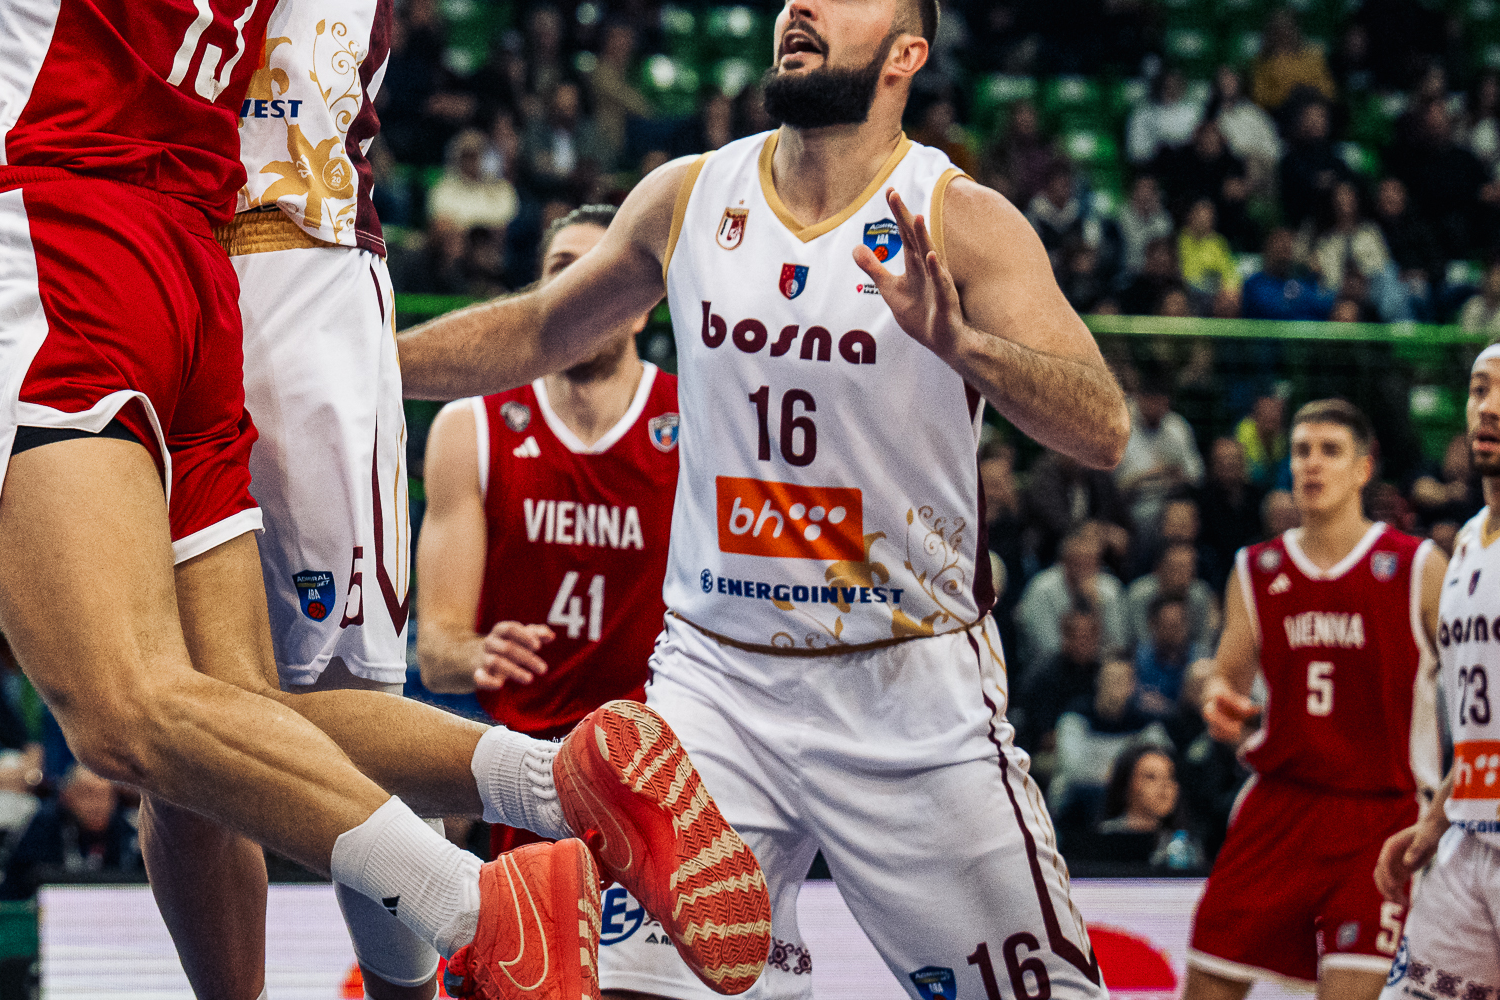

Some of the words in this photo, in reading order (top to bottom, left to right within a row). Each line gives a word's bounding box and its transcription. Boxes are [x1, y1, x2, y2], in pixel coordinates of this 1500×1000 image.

[701, 300, 877, 365] bosna
[748, 384, 818, 468] 16
[523, 498, 645, 551] VIENNA
[729, 496, 785, 540] bh
[547, 570, 606, 642] 41
[717, 576, 904, 604] ENERGOINVEST
[1283, 610, 1366, 650] VIENNA
[1306, 660, 1335, 717] 5
[1376, 900, 1403, 956] 5
[967, 931, 1050, 1000] 16
